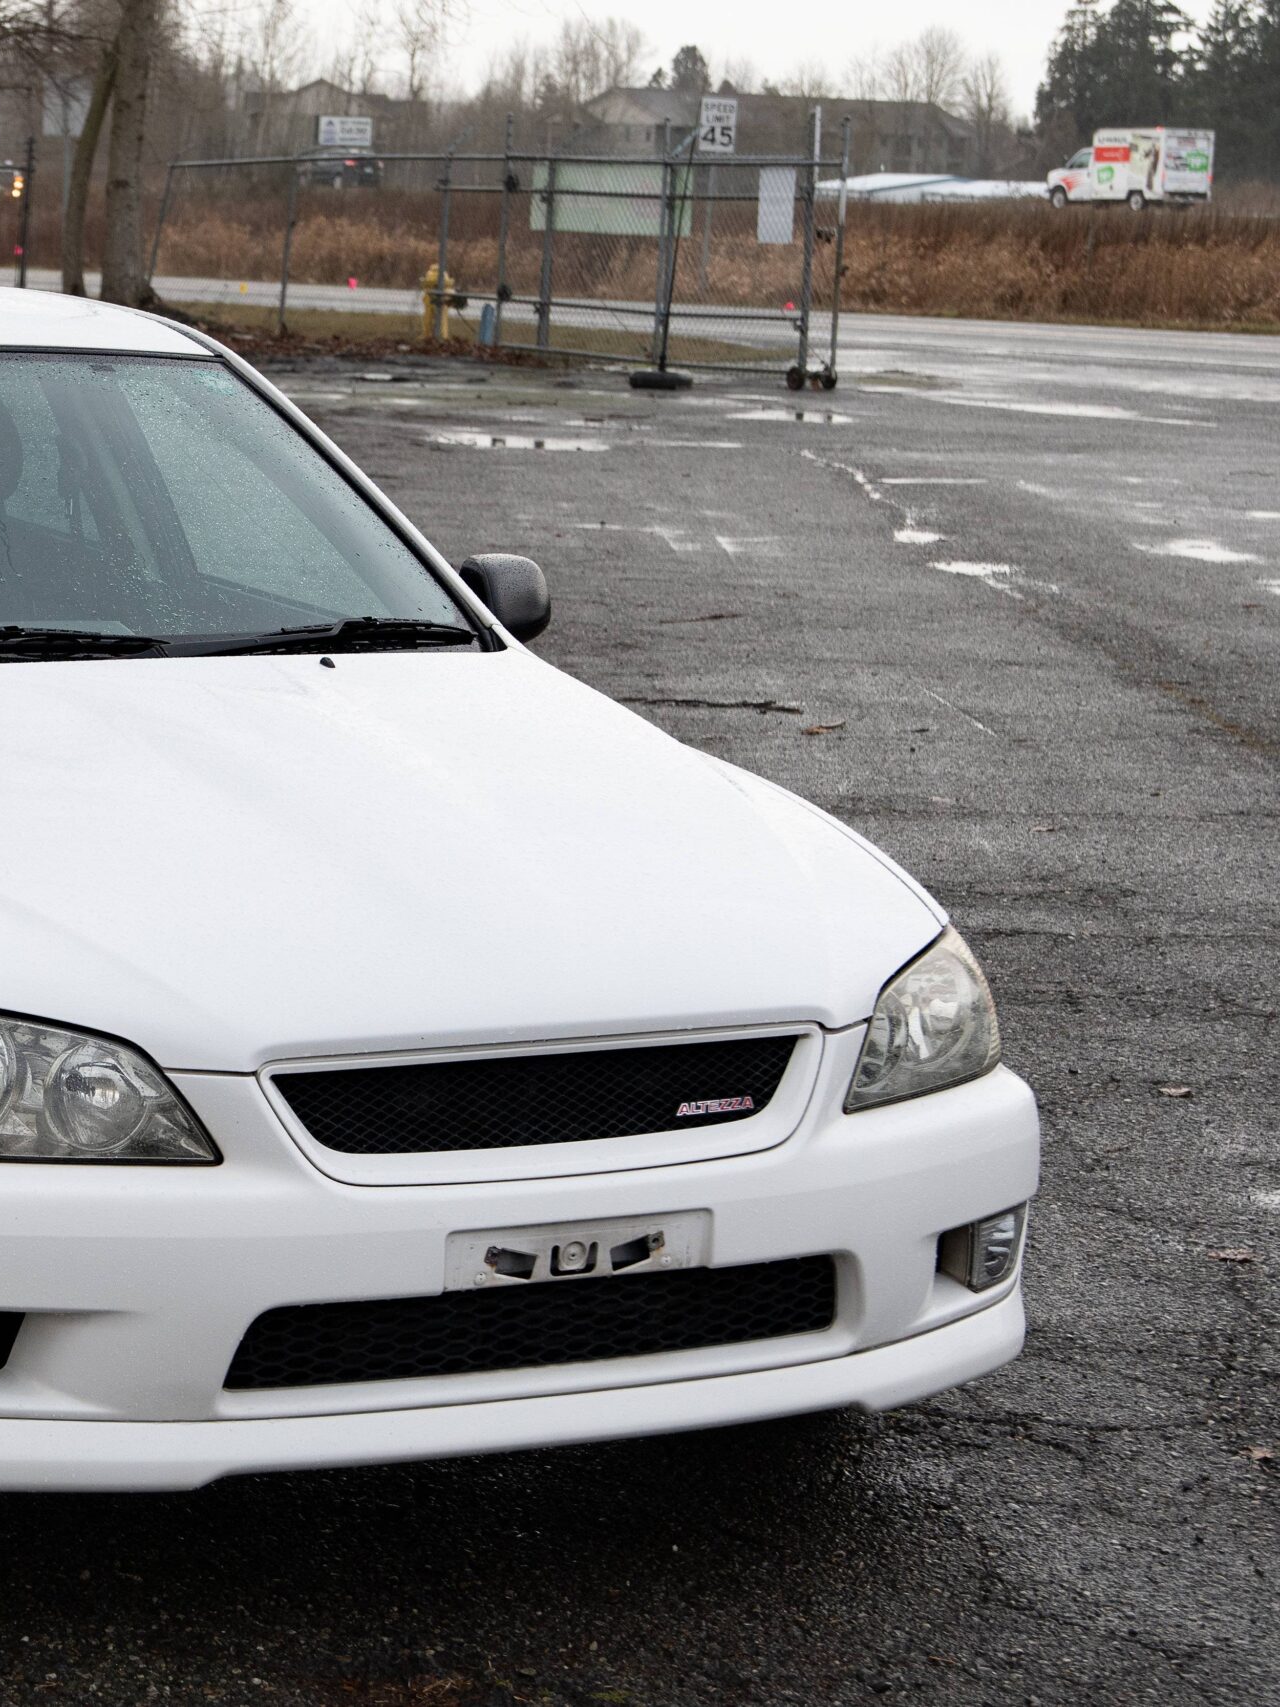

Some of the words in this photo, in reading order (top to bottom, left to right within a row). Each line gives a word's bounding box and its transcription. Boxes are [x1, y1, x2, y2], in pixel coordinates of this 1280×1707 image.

[704, 102, 736, 113] SPEED
[701, 126, 733, 147] 45
[676, 1096, 755, 1116] ALTEZZA
